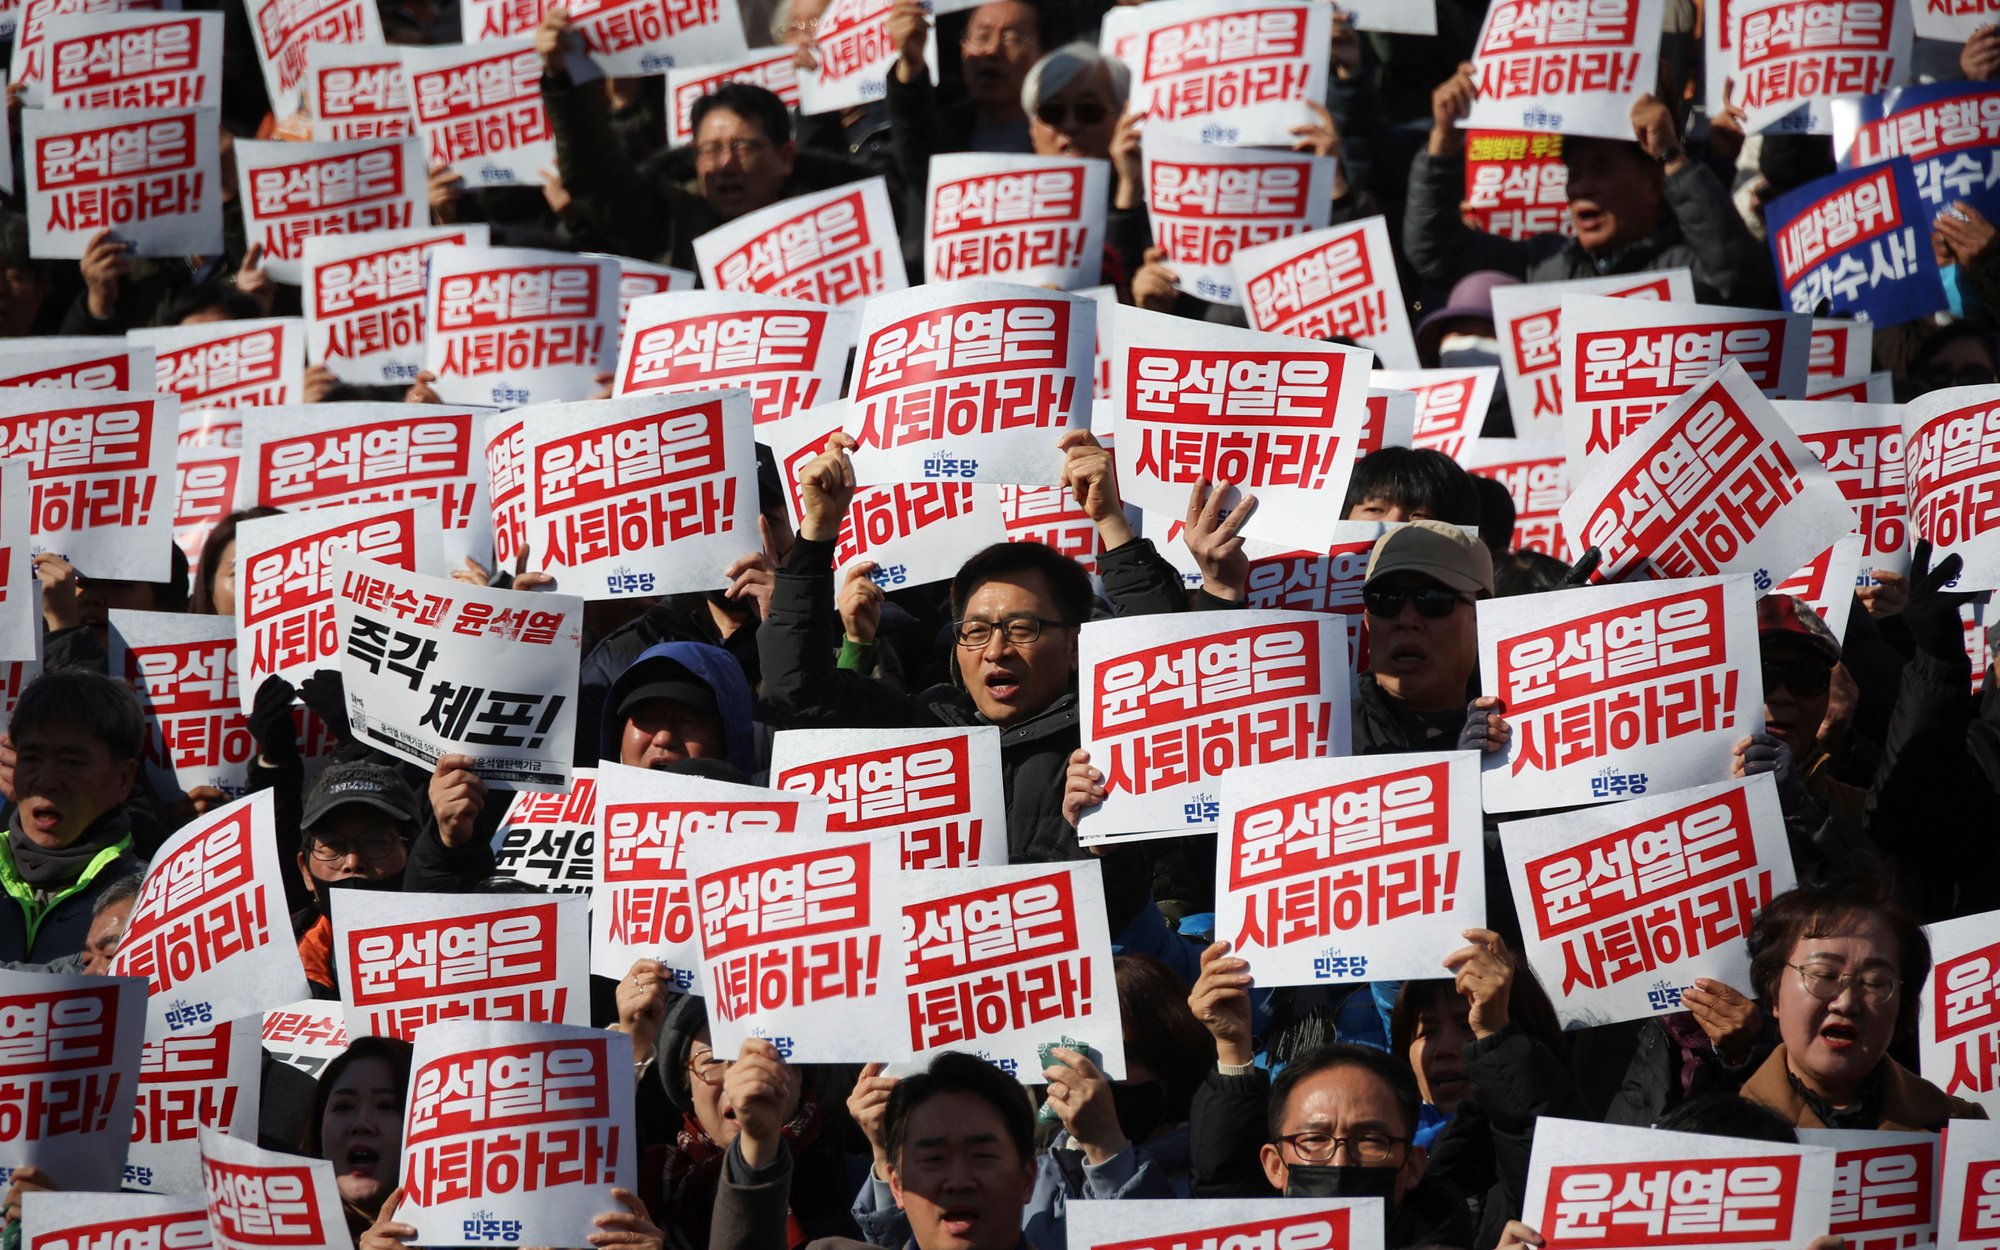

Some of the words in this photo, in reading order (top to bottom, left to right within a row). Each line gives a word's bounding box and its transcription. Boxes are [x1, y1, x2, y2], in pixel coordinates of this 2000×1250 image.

[55, 25, 191, 86] 윤석열은
[580, 0, 720, 57] 사퇴하라!
[1151, 13, 1298, 79] 윤석열은
[1486, 0, 1628, 53] 윤석열은
[1743, 2, 1882, 62] 윤석열은
[416, 55, 544, 118] 윤석열은
[1150, 64, 1311, 121] 사퇴하라!
[1478, 52, 1640, 102] 사퇴하라!
[1740, 56, 1895, 110] 사퇴하라!
[43, 120, 186, 184] 윤석열은
[429, 101, 551, 166] 사퇴하라
[47, 173, 204, 233] 사퇴하라!
[255, 151, 395, 215] 윤석열은
[934, 171, 1076, 234] 윤석열은
[1154, 165, 1300, 215] 윤석열은
[716, 199, 863, 291] 윤석열은
[935, 227, 1088, 282] 사퇴하라!
[1782, 174, 1896, 281] 내란행위
[320, 253, 426, 312] 윤석열
[440, 268, 589, 327] 윤석열은
[1251, 236, 1367, 326] 윤석열은
[325, 304, 425, 359] 사퇴하
[440, 325, 606, 378] 사퇴하라!
[633, 315, 811, 385] 윤석열은
[864, 306, 1056, 390] 윤석열은
[857, 375, 1077, 453] 사퇴하라!
[1135, 355, 1330, 418] 윤석열은
[0, 410, 140, 471] 석열은
[269, 421, 458, 499] 윤석열은
[541, 411, 711, 506] 윤석열은
[923, 459, 979, 478] 민주당
[1136, 428, 1341, 490] 사퇴하라!
[31, 476, 156, 536] 하라!
[543, 476, 737, 569] 사퇴하라!
[833, 482, 973, 574] 퇴하라!
[1648, 440, 1806, 577] 퇴하라!
[607, 573, 656, 594] 민주당
[870, 563, 907, 586] 주당
[1248, 550, 1373, 610] 윤석열
[341, 570, 453, 630] 내란수괴
[452, 603, 564, 646] 윤석열
[347, 614, 438, 692] 즉각
[1102, 629, 1307, 728] 윤석열은
[1508, 597, 1711, 705] 윤석열은
[419, 680, 567, 750] 체포!
[1512, 668, 1740, 779] 사퇴하라!
[1105, 702, 1332, 796] 사퇴하라!
[1184, 802, 1220, 824] 민주
[1591, 773, 1648, 798] 민주당
[1240, 775, 1434, 879] 윤석열은
[130, 820, 243, 932] 석열은
[1538, 803, 1740, 928] 윤석열은
[608, 887, 694, 946] 사퇴하
[702, 854, 855, 947] 윤석열은
[1235, 851, 1460, 954] 사퇴하라!
[357, 914, 542, 995] 윤석열은
[1562, 869, 1772, 999] 사퇴하라!
[713, 934, 882, 1023] 사퇴하라!
[1313, 955, 1368, 979] 민주당
[1647, 985, 1696, 1011] 민주
[164, 1003, 213, 1031] 민주당
[409, 1047, 595, 1138] 윤석열은
[123, 1166, 153, 1187] 주당
[401, 1126, 619, 1209] 사퇴하라!
[463, 1220, 522, 1241] 민주당
[1554, 1165, 1782, 1240] 윤석열은
